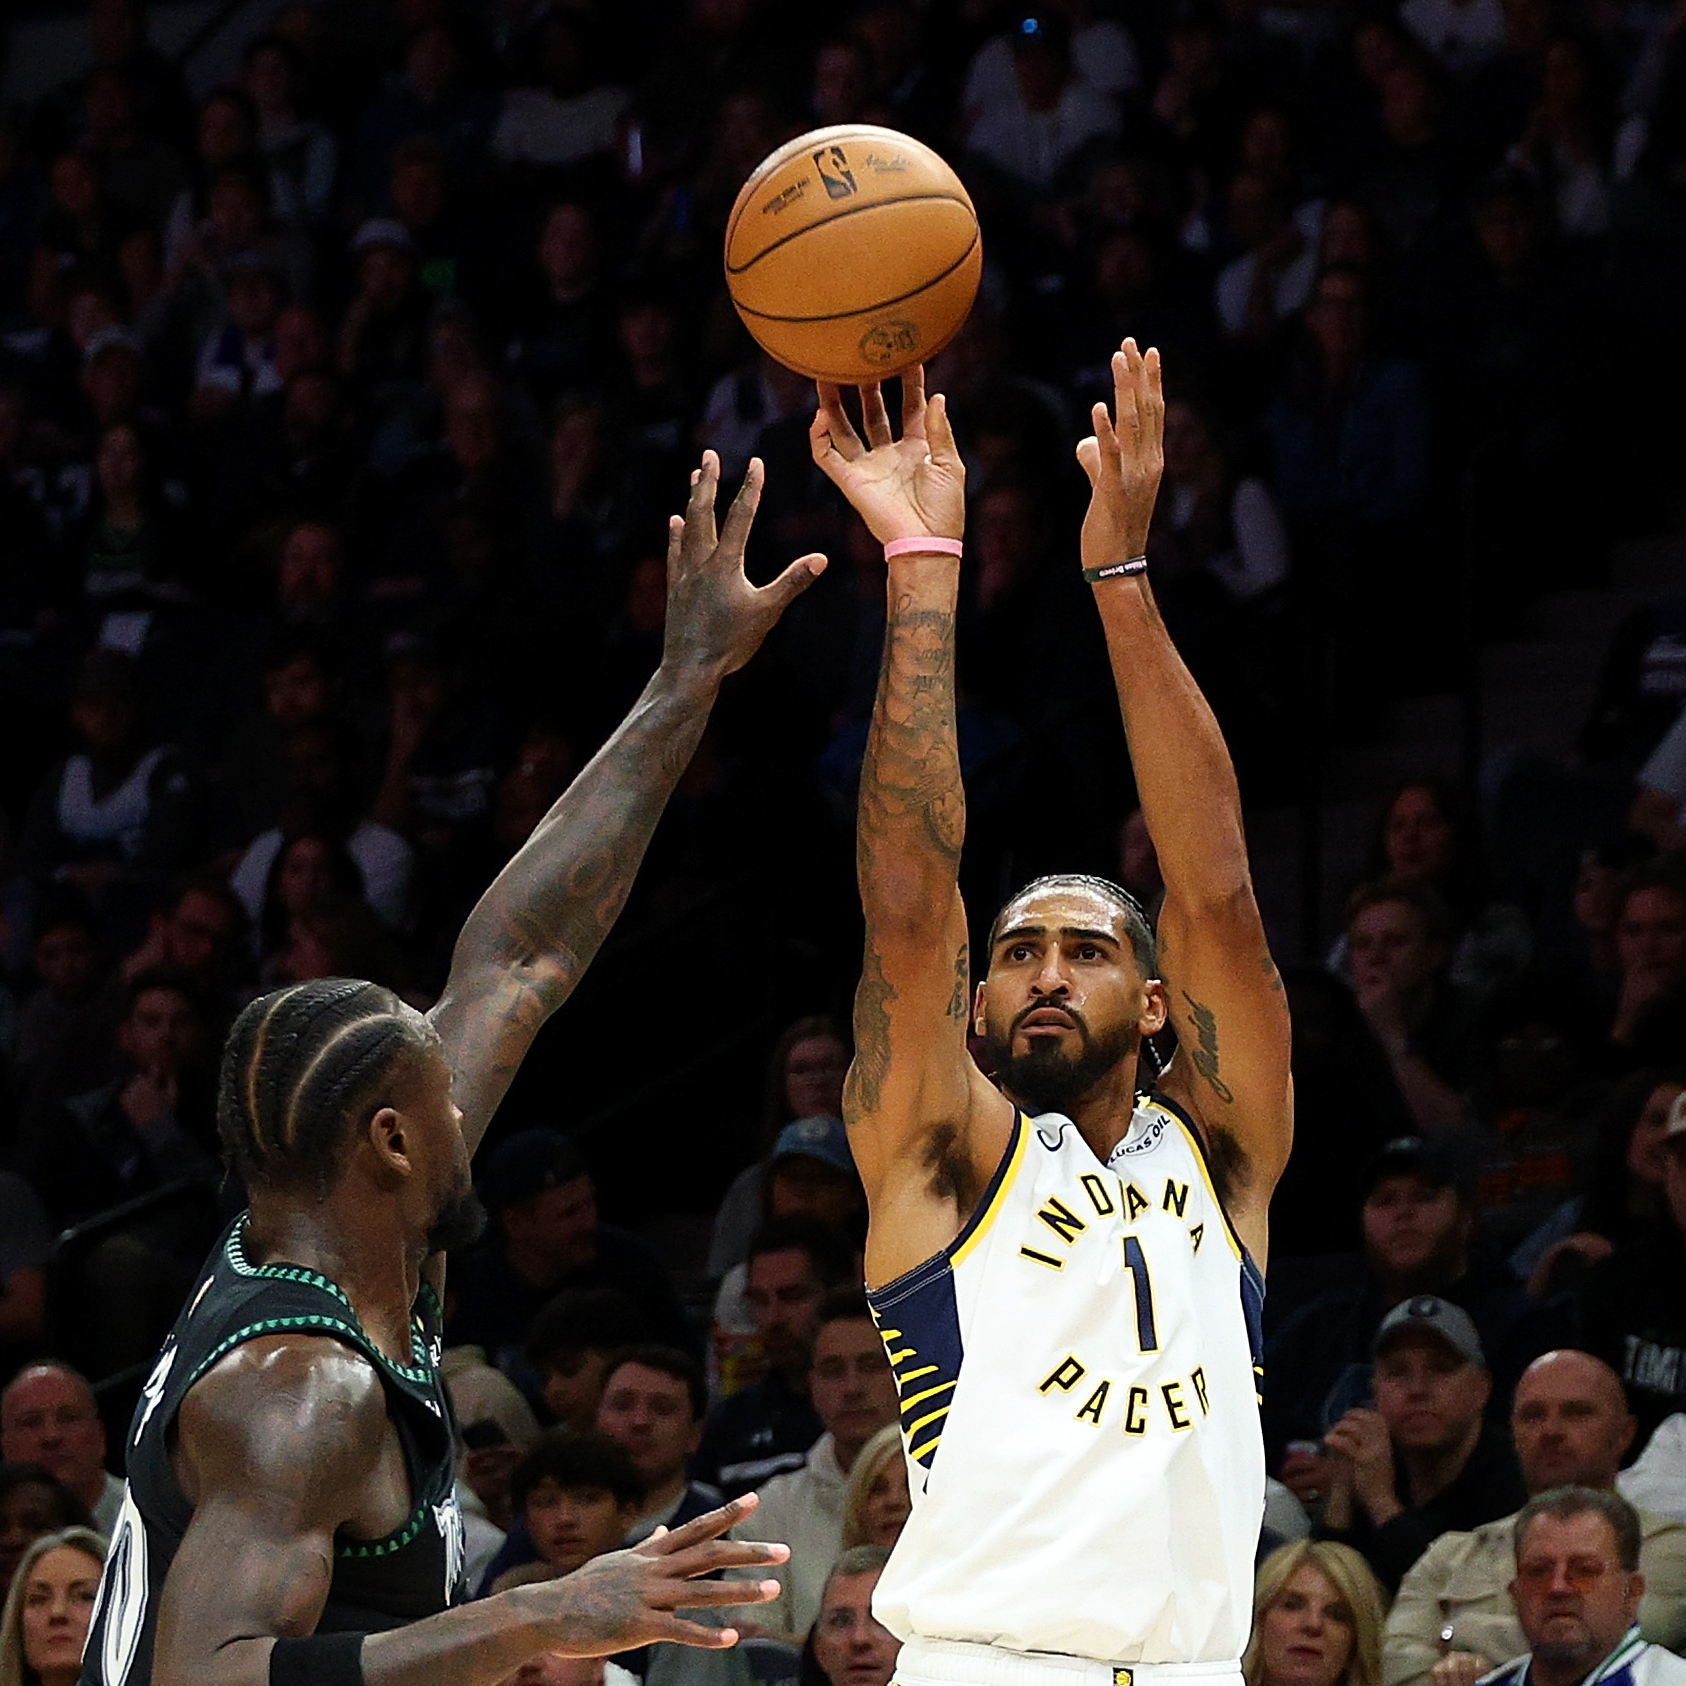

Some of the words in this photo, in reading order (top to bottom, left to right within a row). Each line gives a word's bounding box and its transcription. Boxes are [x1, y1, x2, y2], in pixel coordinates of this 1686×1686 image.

[1109, 1137, 1153, 1164] LUCAS
[1152, 1114, 1171, 1138] OIL
[1121, 1234, 1157, 1355] 1
